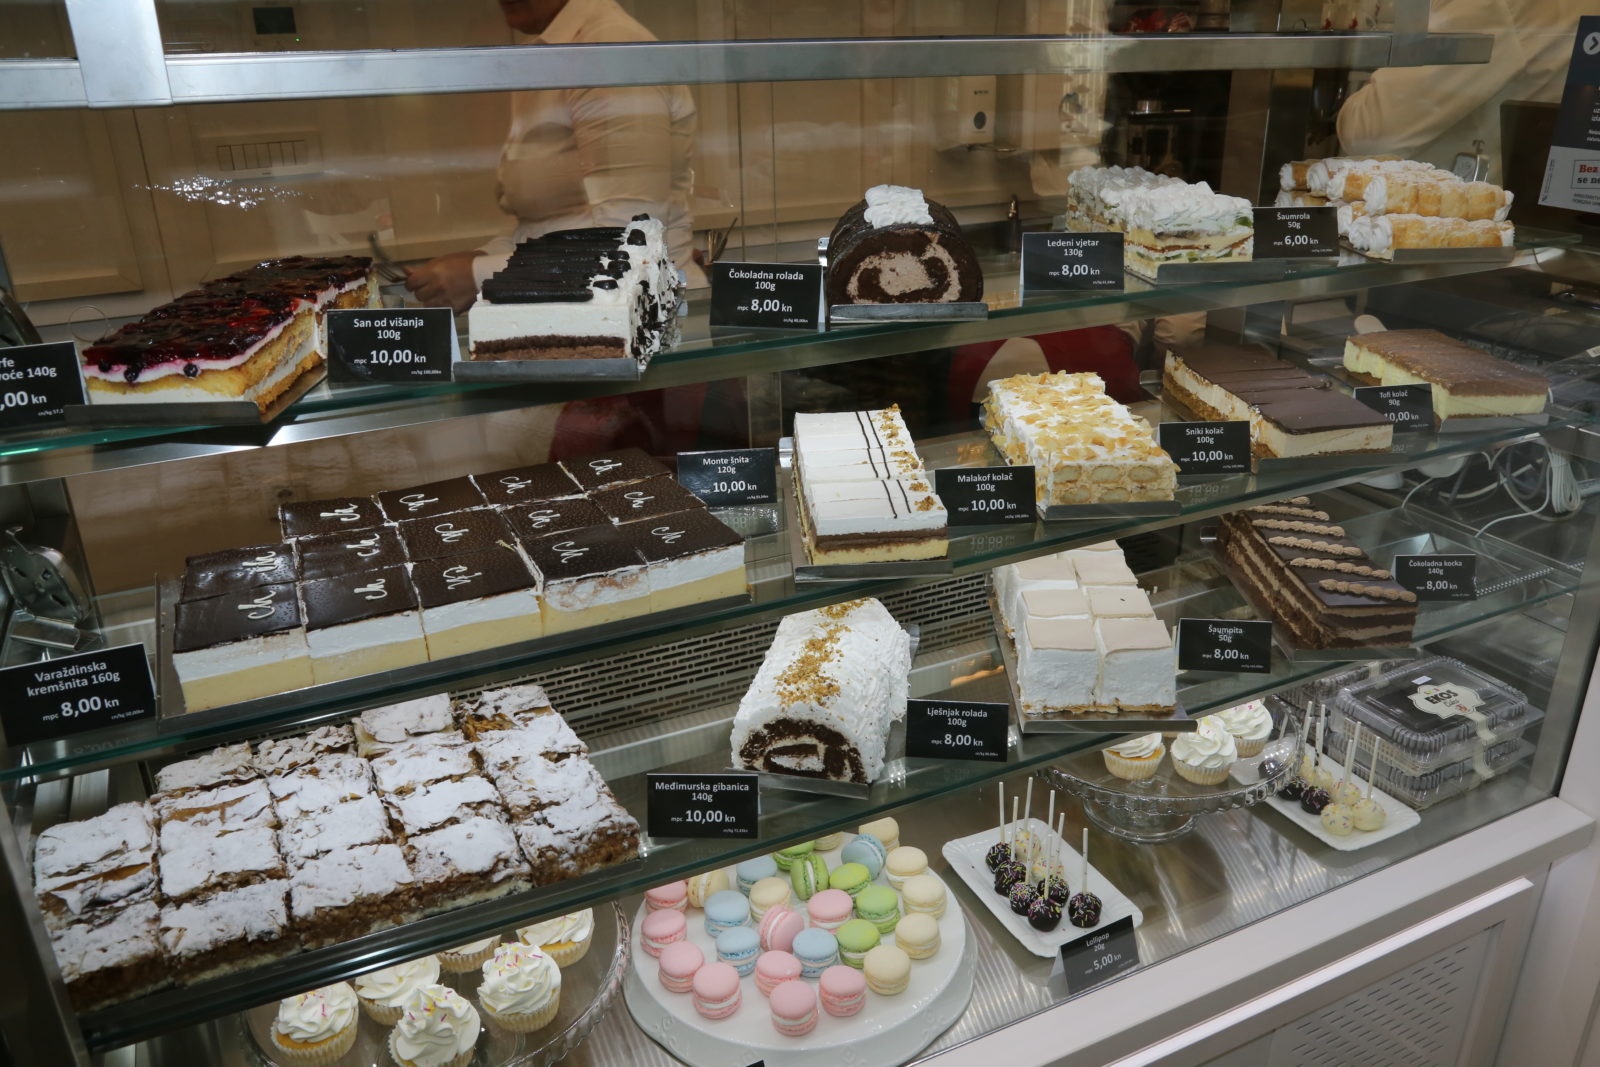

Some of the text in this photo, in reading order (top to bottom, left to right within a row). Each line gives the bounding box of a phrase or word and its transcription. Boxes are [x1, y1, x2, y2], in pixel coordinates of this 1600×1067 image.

[1579, 165, 1599, 173] Bez
[1277, 212, 1310, 220] Šaumrola
[1076, 239, 1099, 248] vjetar
[1285, 235, 1308, 246] 6,00
[1064, 249, 1083, 257] 130g
[729, 269, 803, 280] Čokoladna rolada
[1062, 265, 1088, 277] 8,00
[755, 282, 776, 291] 100g
[751, 299, 780, 313] 8,00
[782, 304, 792, 312] kn
[354, 317, 424, 328] San od višanja
[377, 330, 400, 340] 100g
[370, 350, 412, 366] 10,00
[414, 354, 426, 363] kn
[27, 366, 57, 378] 140g
[31, 394, 47, 405] kn
[703, 457, 728, 466] Monte
[1192, 451, 1222, 462] 10,00
[718, 466, 736, 474] 120g
[958, 474, 990, 482] Malakof
[713, 481, 745, 493] 10,00
[976, 484, 995, 492] 100g
[971, 499, 1005, 512] 10,00
[1427, 581, 1448, 590] 8,00
[1208, 624, 1243, 634] Šaumpita
[1219, 635, 1232, 643] 50g
[1214, 648, 1238, 660] 8,00
[35, 661, 107, 682] Varaždinska
[27, 672, 120, 697] kremšnita 160g
[42, 696, 119, 721] mpc 8,00 kn
[927, 708, 988, 718] Lješnjak rolada
[948, 718, 967, 727] 100g
[944, 734, 971, 747] 8,00
[973, 738, 983, 747] kn
[655, 782, 749, 792] Međimurska gibanica
[692, 793, 713, 802] 140g
[686, 810, 723, 824] 10,00
[725, 814, 735, 823] kn
[1086, 933, 1110, 946] Lollipop
[1094, 943, 1105, 951] 20g
[1094, 954, 1113, 970] 5,00
